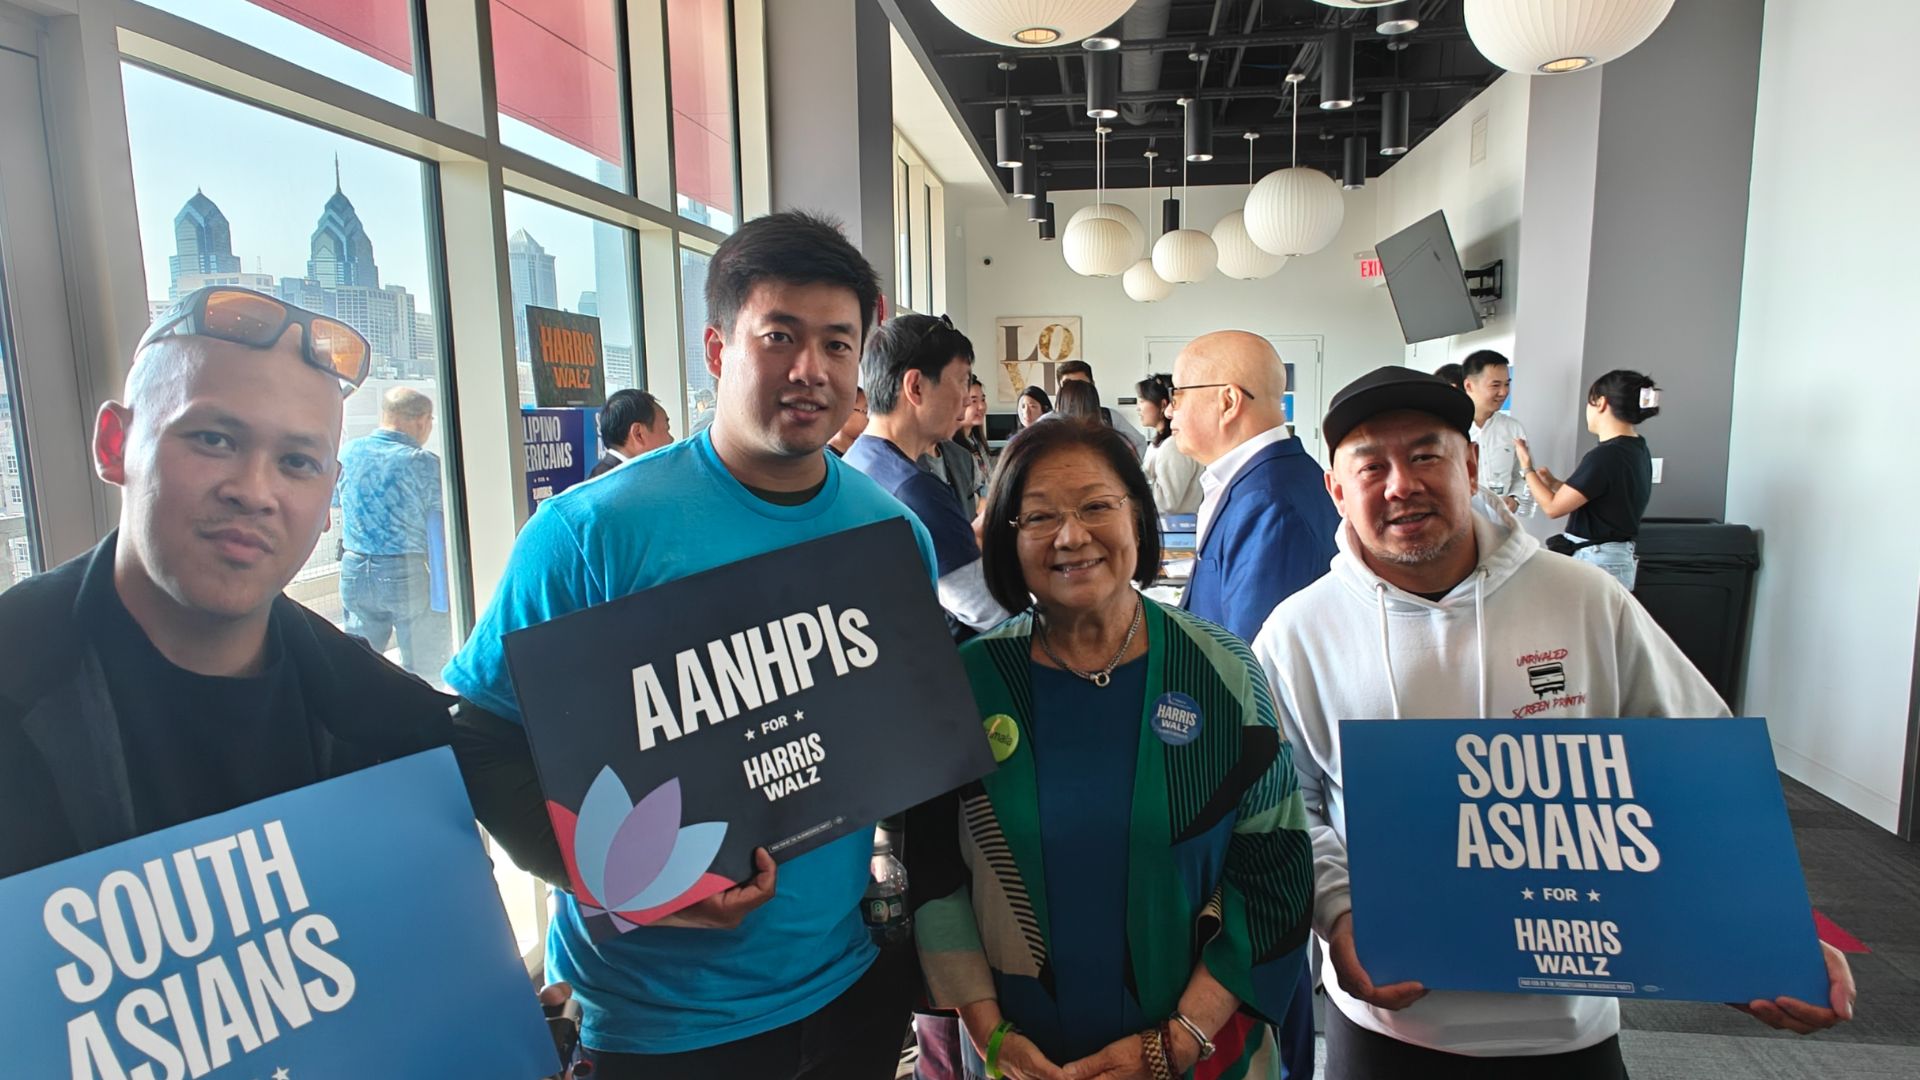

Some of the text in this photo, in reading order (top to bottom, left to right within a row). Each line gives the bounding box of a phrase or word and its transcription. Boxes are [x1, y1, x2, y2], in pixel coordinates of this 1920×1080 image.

[540, 326, 595, 367] HARRIS
[552, 366, 591, 388] WALZ
[522, 416, 561, 443] LIPINO
[524, 442, 573, 472] ERICANS
[1157, 703, 1197, 727] HARRIS
[1512, 692, 1586, 719] SCREEN PRINTIN
[761, 715, 788, 735] FOR
[1161, 718, 1189, 734] WALZ
[743, 732, 826, 790] HARRIS
[1455, 733, 1634, 799] SOUTH
[763, 765, 822, 802] WALZ
[1456, 802, 1660, 873] ASIANS
[1543, 887, 1578, 901] FOR
[43, 819, 310, 1003] SOUTH
[1514, 918, 1622, 955] HARRIS
[1533, 954, 1611, 977] WALZ
[66, 914, 356, 1080] ASIANS
